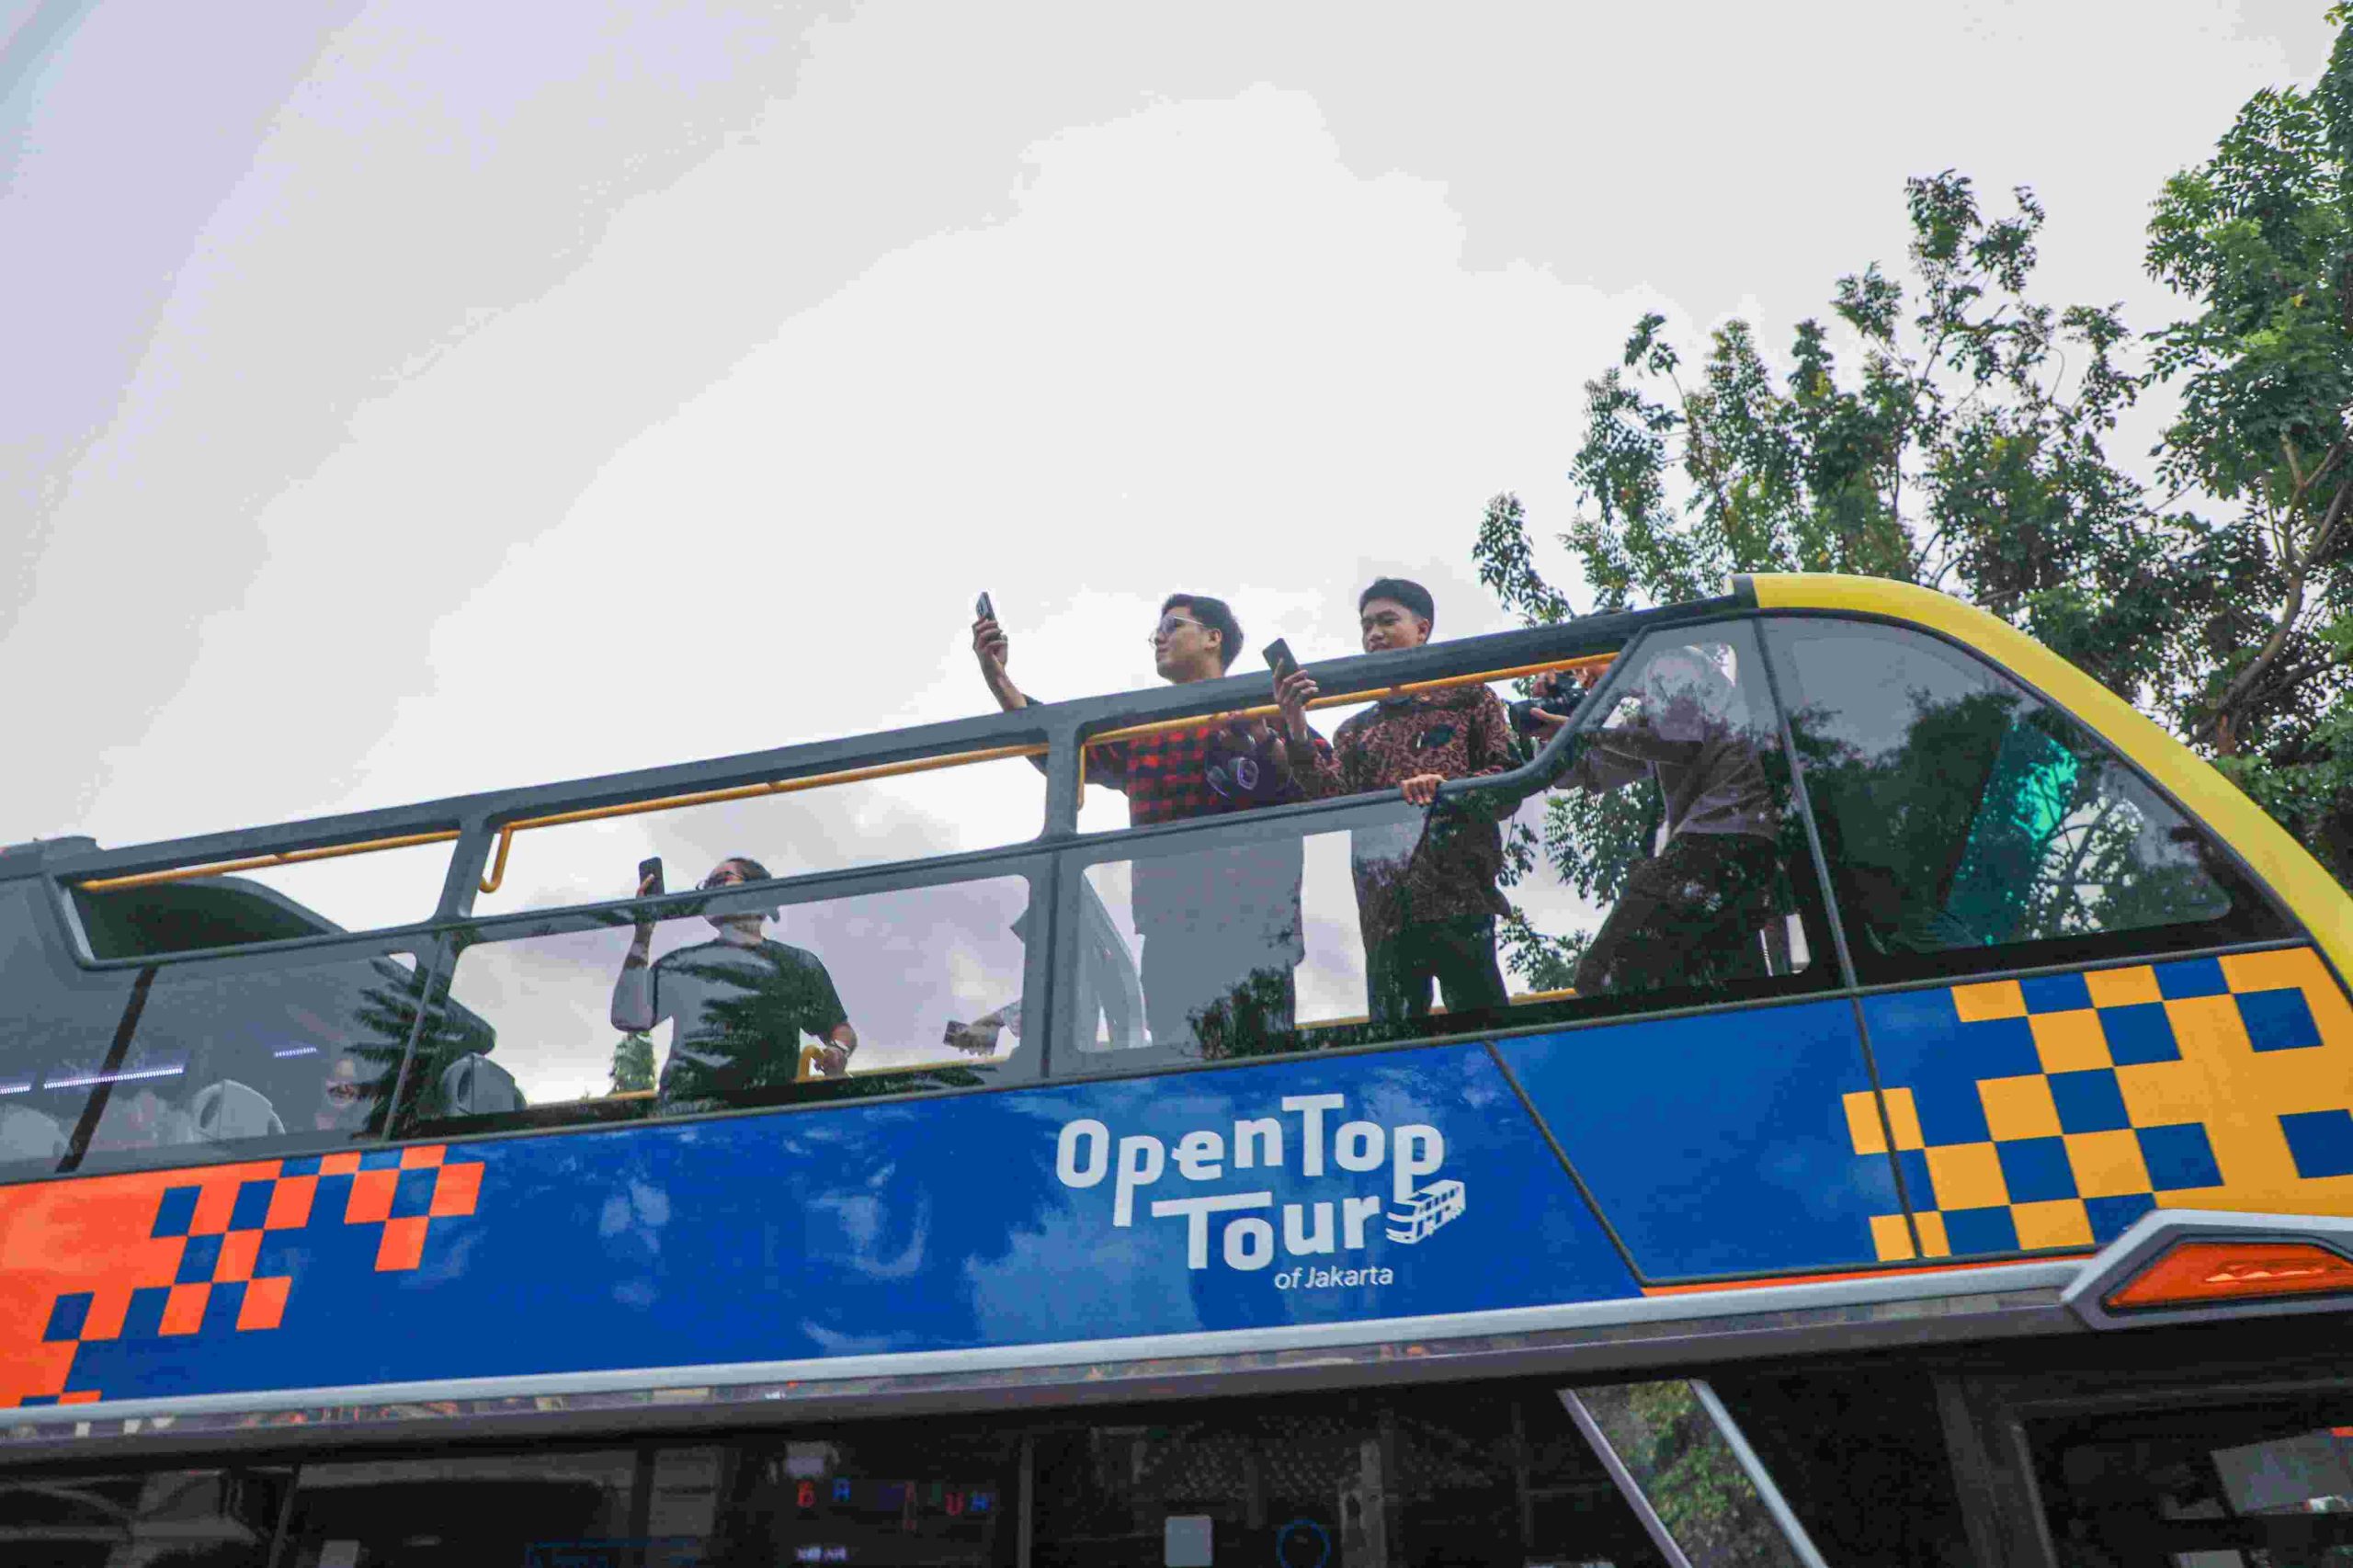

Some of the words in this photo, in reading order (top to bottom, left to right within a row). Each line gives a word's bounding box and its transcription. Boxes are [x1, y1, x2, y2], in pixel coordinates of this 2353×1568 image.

[1151, 1190, 1381, 1271] Tour
[1274, 1267, 1303, 1290] of
[1304, 1265, 1393, 1289] Jakarta
